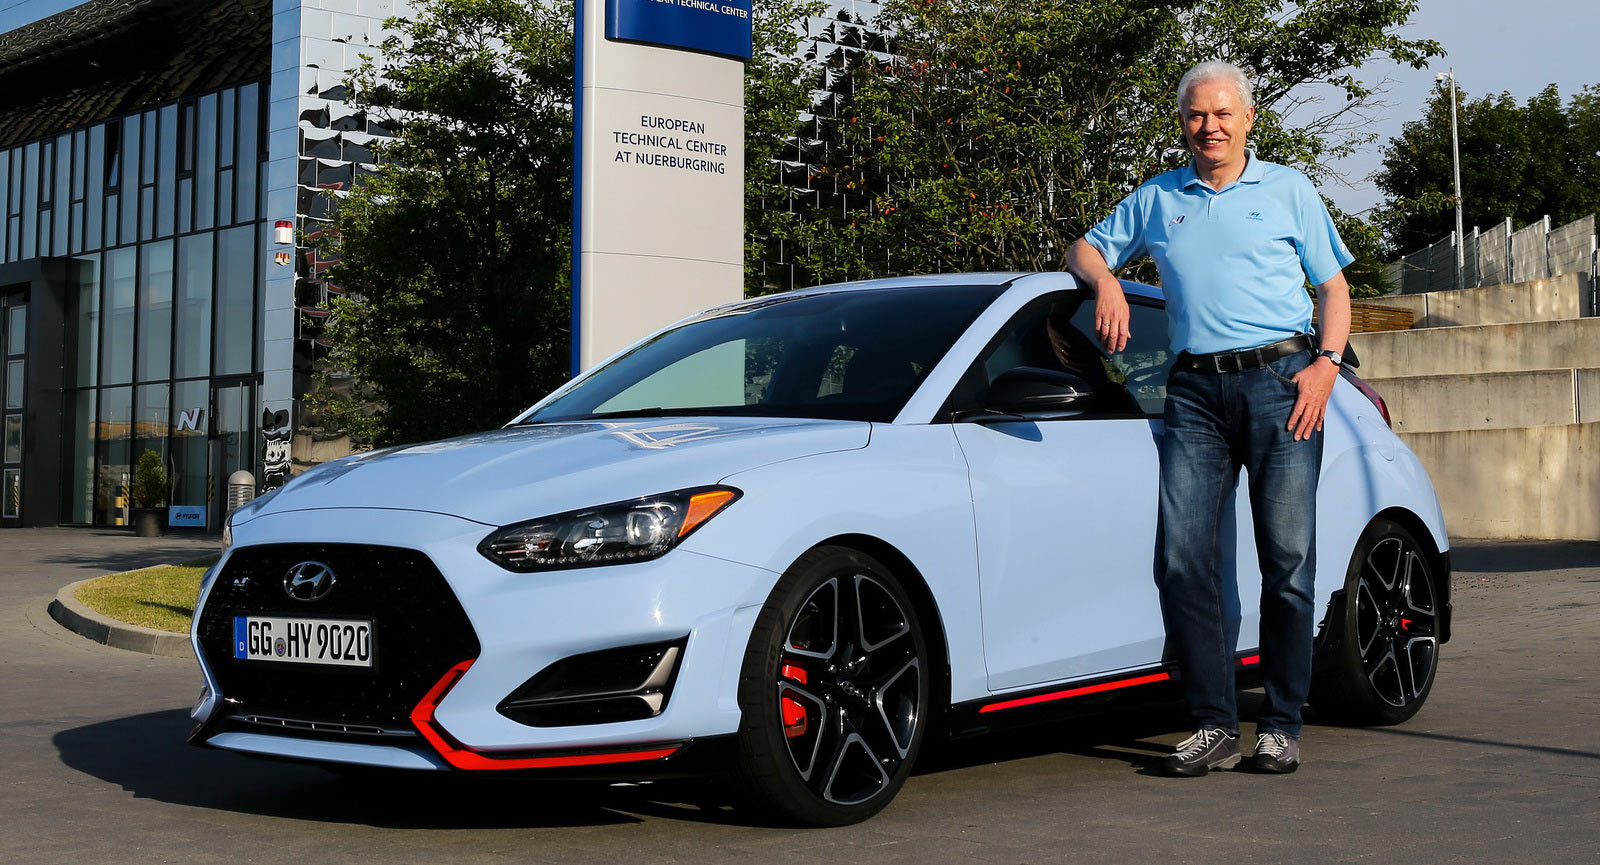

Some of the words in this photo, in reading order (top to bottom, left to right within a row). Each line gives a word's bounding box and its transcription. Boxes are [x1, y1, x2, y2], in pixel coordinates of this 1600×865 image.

[721, 5, 748, 19] CENTER
[641, 115, 705, 135] EUROPEAN
[613, 131, 682, 150] TECHNICAL
[686, 139, 727, 156] CENTER
[615, 151, 631, 163] AT
[635, 152, 725, 175] NUERBURGRING
[177, 407, 200, 431] N
[239, 641, 245, 652] D
[248, 621, 272, 656] GG
[287, 622, 313, 658] HY
[317, 624, 369, 662] 9020
